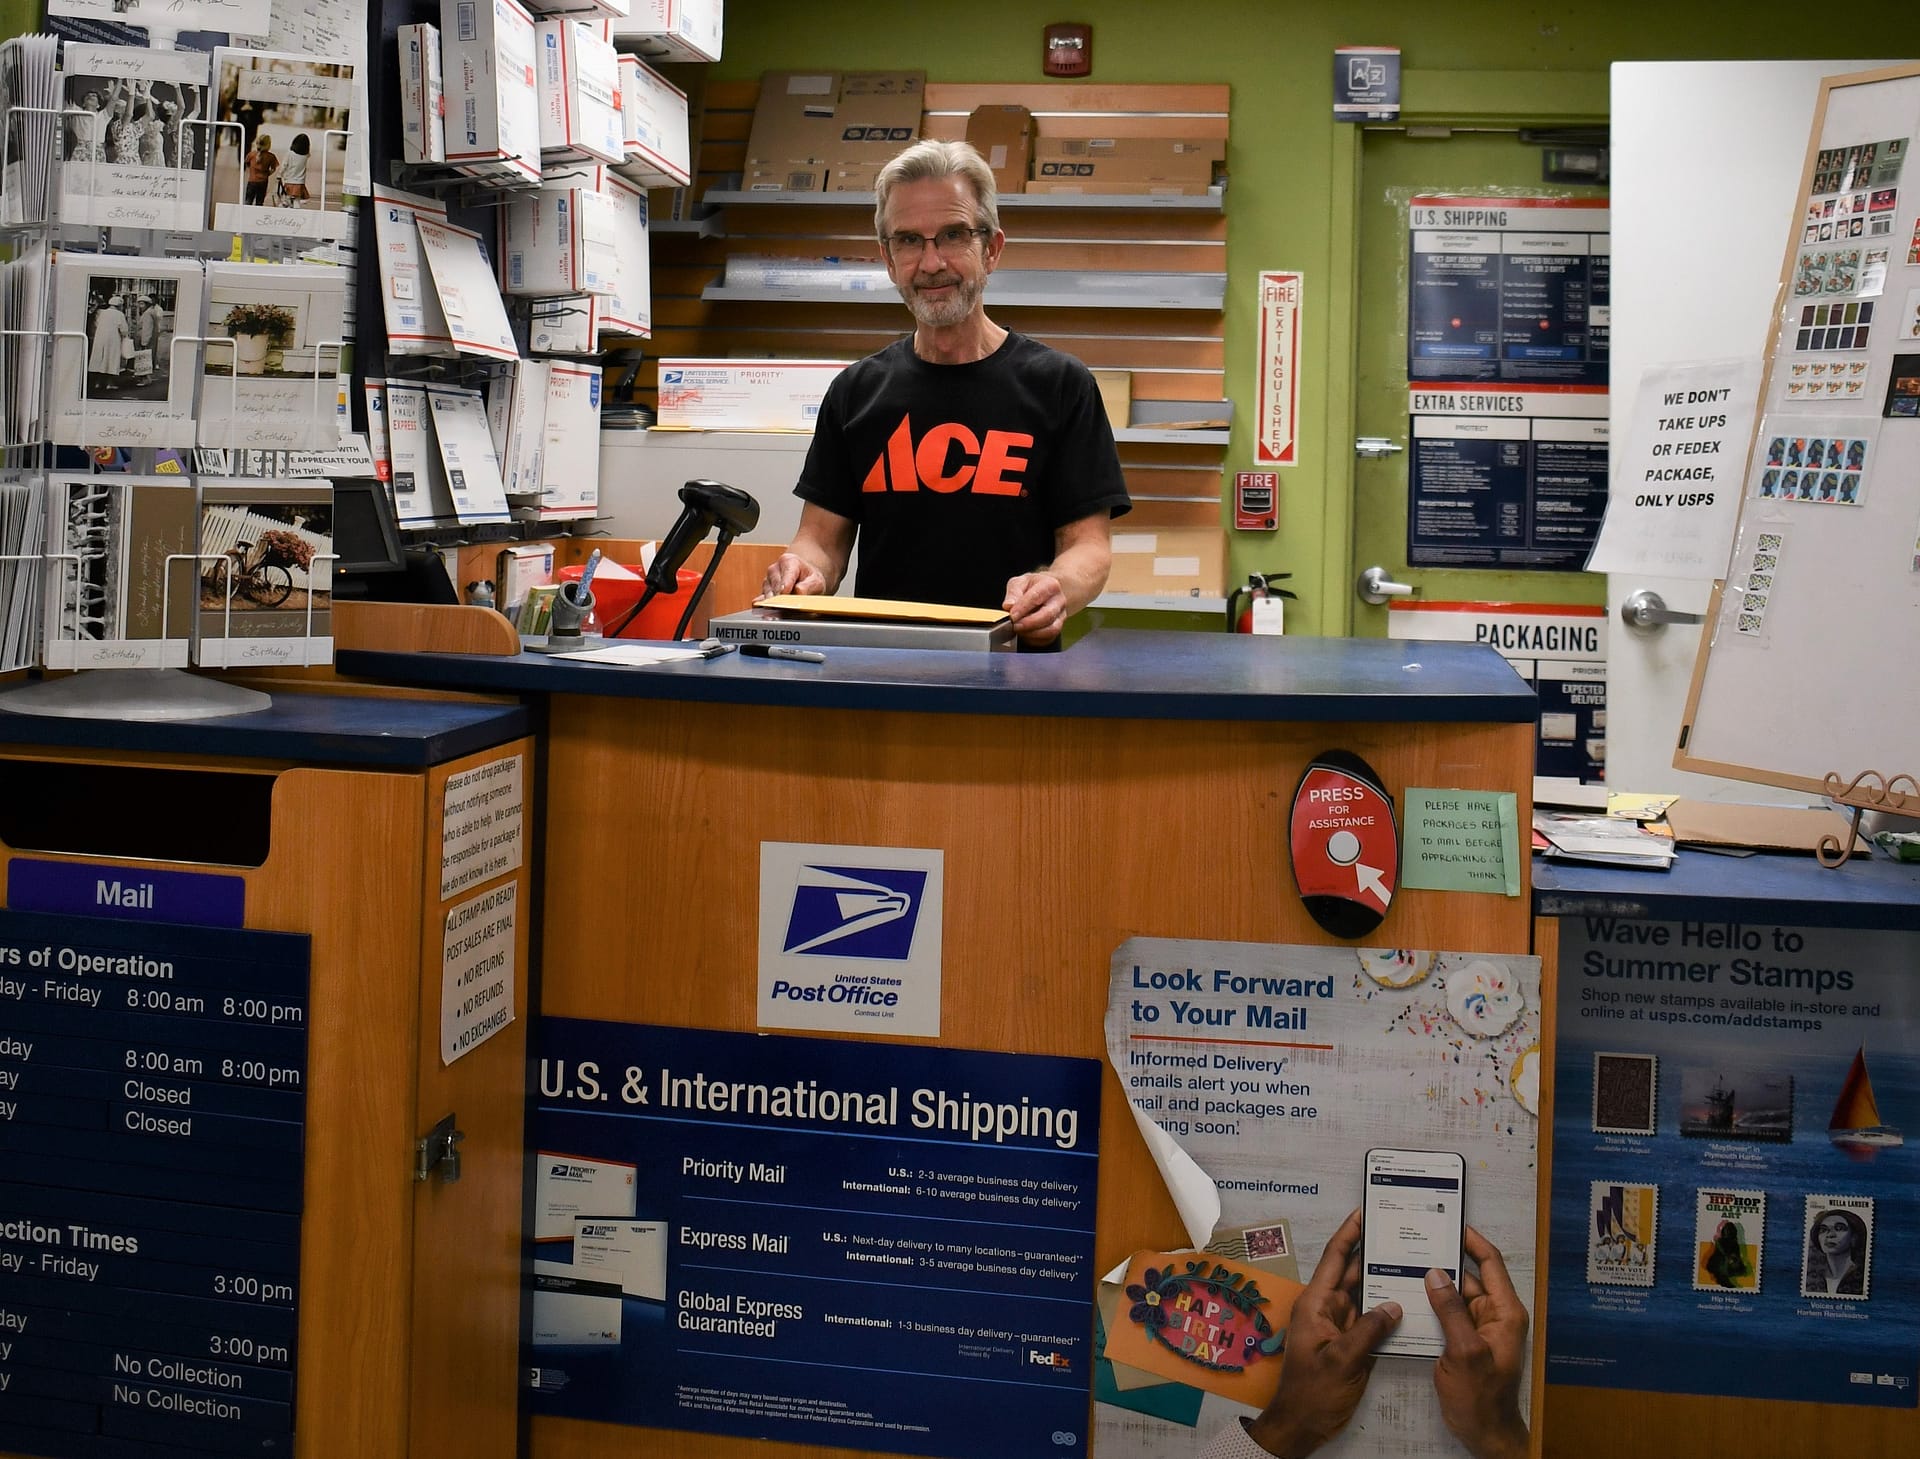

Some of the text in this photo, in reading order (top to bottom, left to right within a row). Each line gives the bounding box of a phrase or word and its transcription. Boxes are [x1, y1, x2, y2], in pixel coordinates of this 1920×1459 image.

[1414, 210, 1507, 226] U.S. SHIPPING
[1266, 287, 1294, 303] FIRE
[740, 370, 781, 378] PRIORITY
[1271, 306, 1284, 453] EXTINGUISHER
[391, 394, 416, 406] PRIORITY
[1415, 395, 1523, 412] EXTRA SERVICES
[1664, 389, 1731, 406] WE DON'T
[393, 420, 417, 430] EXPRESS
[1659, 415, 1727, 431] TAKE UPS
[862, 412, 1033, 496] ACE
[1652, 440, 1721, 457] OR FEDEX
[1240, 474, 1273, 487] FIRE
[1645, 467, 1715, 483] PACKAGE,
[1635, 492, 1715, 507] ONLY USPS
[715, 627, 801, 641] METTLER TOLEDO
[1476, 623, 1598, 652] PACKAGING
[1562, 684, 1605, 695] EXPECTED
[1310, 787, 1364, 803] PRESS
[1425, 801, 1492, 812] PLEASE HAVE
[462, 820, 472, 836] able
[495, 810, 504, 821] We
[1309, 816, 1375, 829] ASSISTANCE
[1329, 805, 1350, 815] FOR
[1423, 819, 1477, 830] PACKAGES
[1420, 837, 1503, 848] TO MAIL BEFORE
[1421, 852, 1487, 864] APPROACHING
[96, 879, 154, 909] Mail
[447, 884, 515, 931] ALL STAMP AND READY
[447, 914, 512, 962] POST SALES ARE FINAL
[1585, 916, 1804, 953] Wave Hello to
[28, 947, 52, 967] of
[58, 948, 174, 979] Operation
[463, 950, 505, 986] NO RETURNS
[1583, 950, 1855, 996] Summer Stamps
[835, 974, 902, 987] United States
[1132, 966, 1334, 999] Look Forward
[44, 980, 101, 1007] Friday
[127, 988, 171, 1010] 8:00
[175, 996, 204, 1012] am
[223, 997, 267, 1018] 8:00
[271, 1004, 302, 1023] pm
[463, 980, 504, 1016] NO REFUNDS
[772, 981, 899, 1007] Post Office
[1582, 987, 1881, 1017] Shop new stamps available in-store and
[854, 1009, 880, 1017] Contract
[1131, 1000, 1307, 1030] to Your Mail
[1581, 1006, 1822, 1032] online at usps.com/addstamps
[459, 1006, 507, 1049] NO EXCHANGES
[125, 1050, 300, 1086] 8:00 am 8:00 pm
[1130, 1051, 1207, 1069] Informed
[124, 1080, 191, 1105] Closed
[1130, 1074, 1310, 1096] emails alert you when
[540, 1058, 1078, 1150] U.S. & International Shipping
[1168, 1097, 1199, 1111] and
[1205, 1100, 1285, 1119] packages
[1290, 1106, 1318, 1118] are
[125, 1110, 192, 1136] Closed
[682, 1157, 786, 1184] Priority Mail
[888, 1168, 1078, 1194] U.S.: 2-3 average business day delivery
[1706, 1204, 1760, 1214] GRAFFITI
[68, 1225, 139, 1254] Times
[680, 1227, 788, 1256] Express Mail
[41, 1253, 99, 1282] Friday
[214, 1275, 293, 1302] 3:00 pm
[679, 1290, 803, 1321] Global Express
[678, 1311, 776, 1339] Guaranteed
[210, 1335, 288, 1363] 3:00 pm
[1029, 1350, 1070, 1367] FedEx
[115, 1353, 242, 1389] No Collection
[114, 1384, 241, 1420] No Collection
